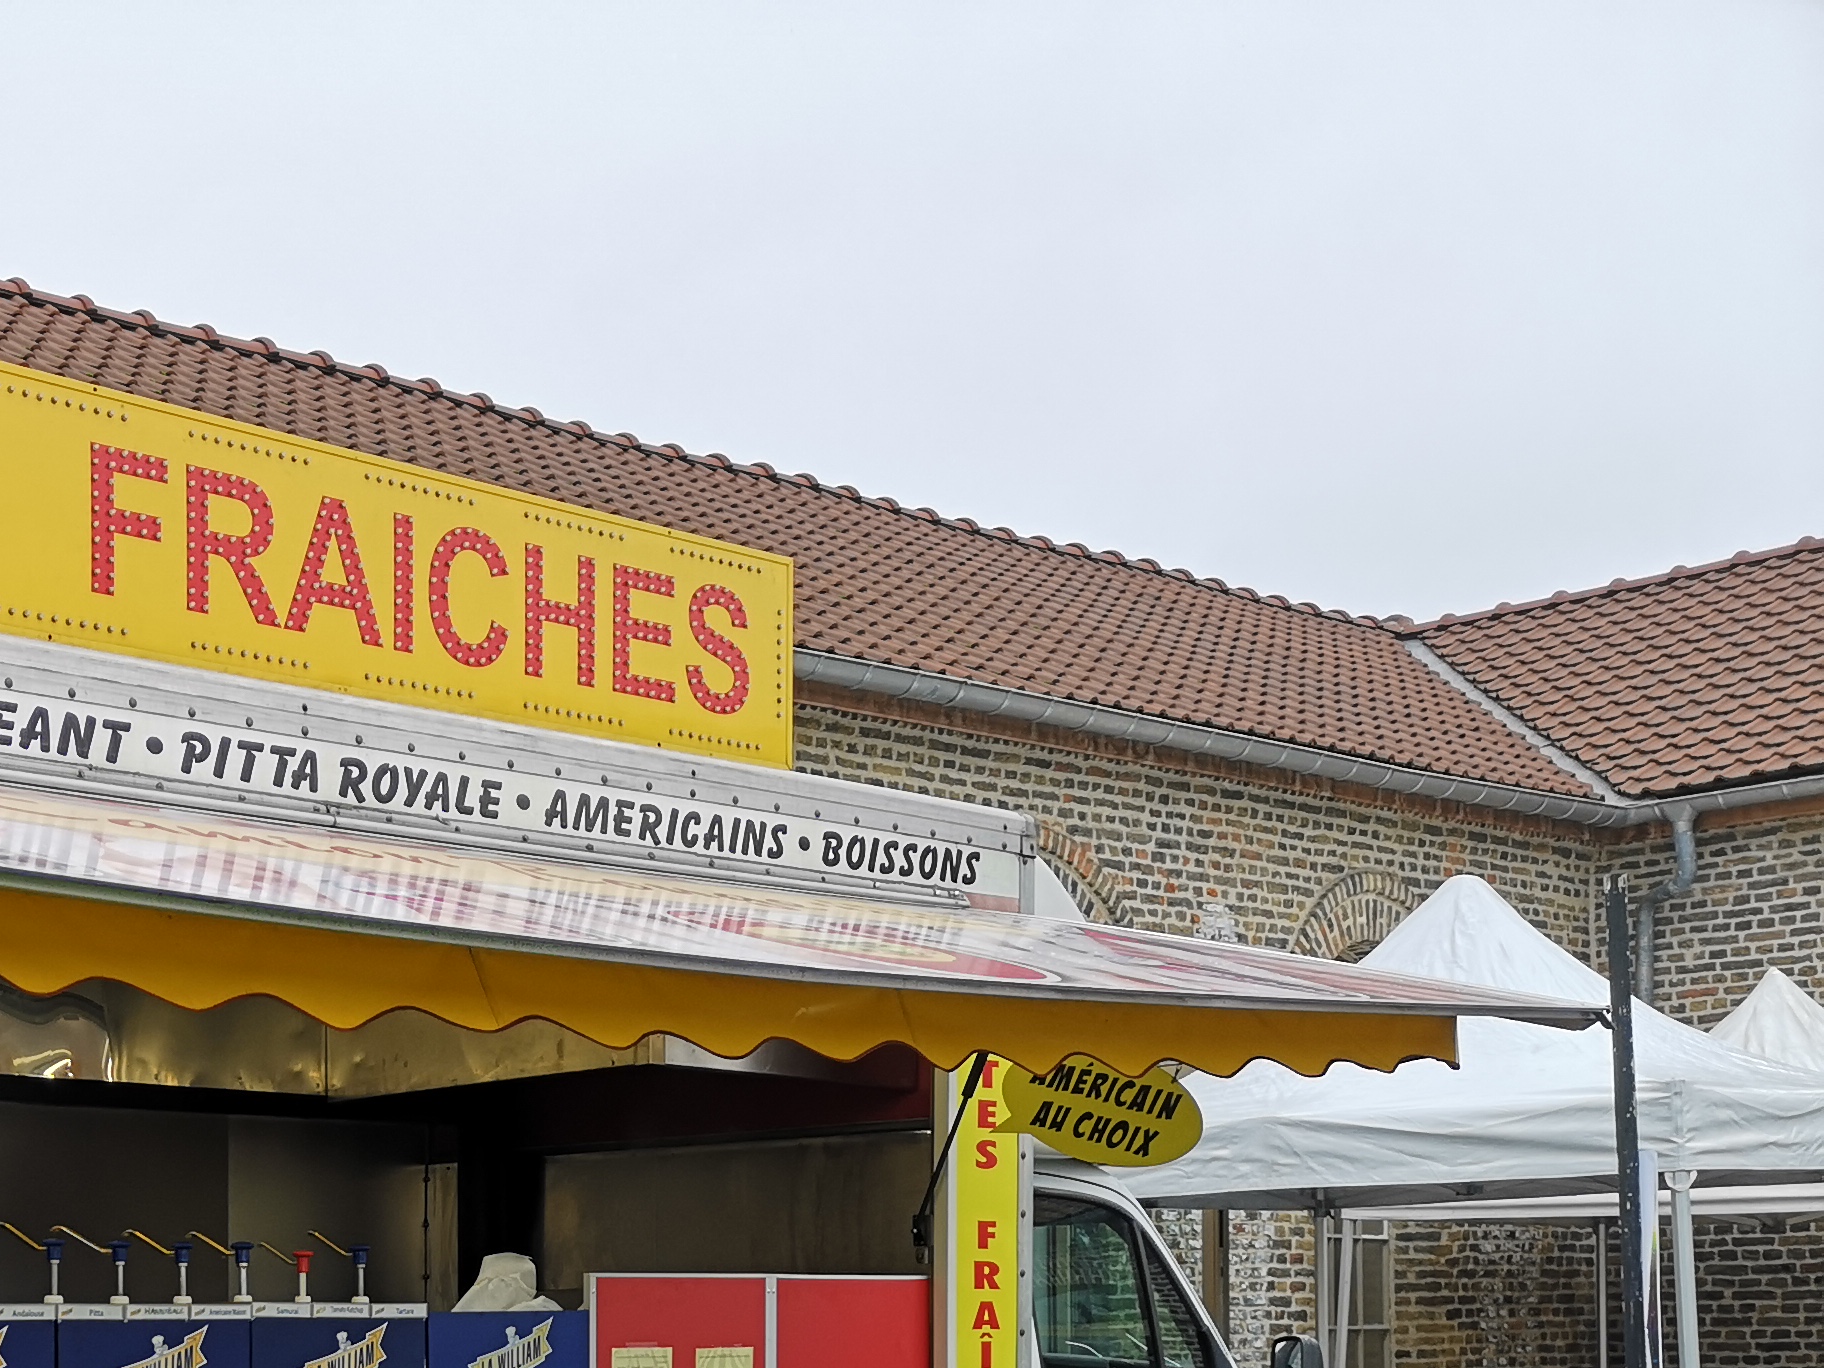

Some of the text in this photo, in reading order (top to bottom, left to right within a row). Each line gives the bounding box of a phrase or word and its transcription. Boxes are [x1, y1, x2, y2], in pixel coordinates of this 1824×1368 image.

[90, 441, 750, 716] FRAICHES
[179, 730, 503, 821] PITTA ROYALE
[544, 789, 788, 860] AMERICAINS
[821, 830, 981, 886] BOISSONS
[975, 1060, 999, 1169] TES
[1029, 1100, 1160, 1158] AU CHOIX
